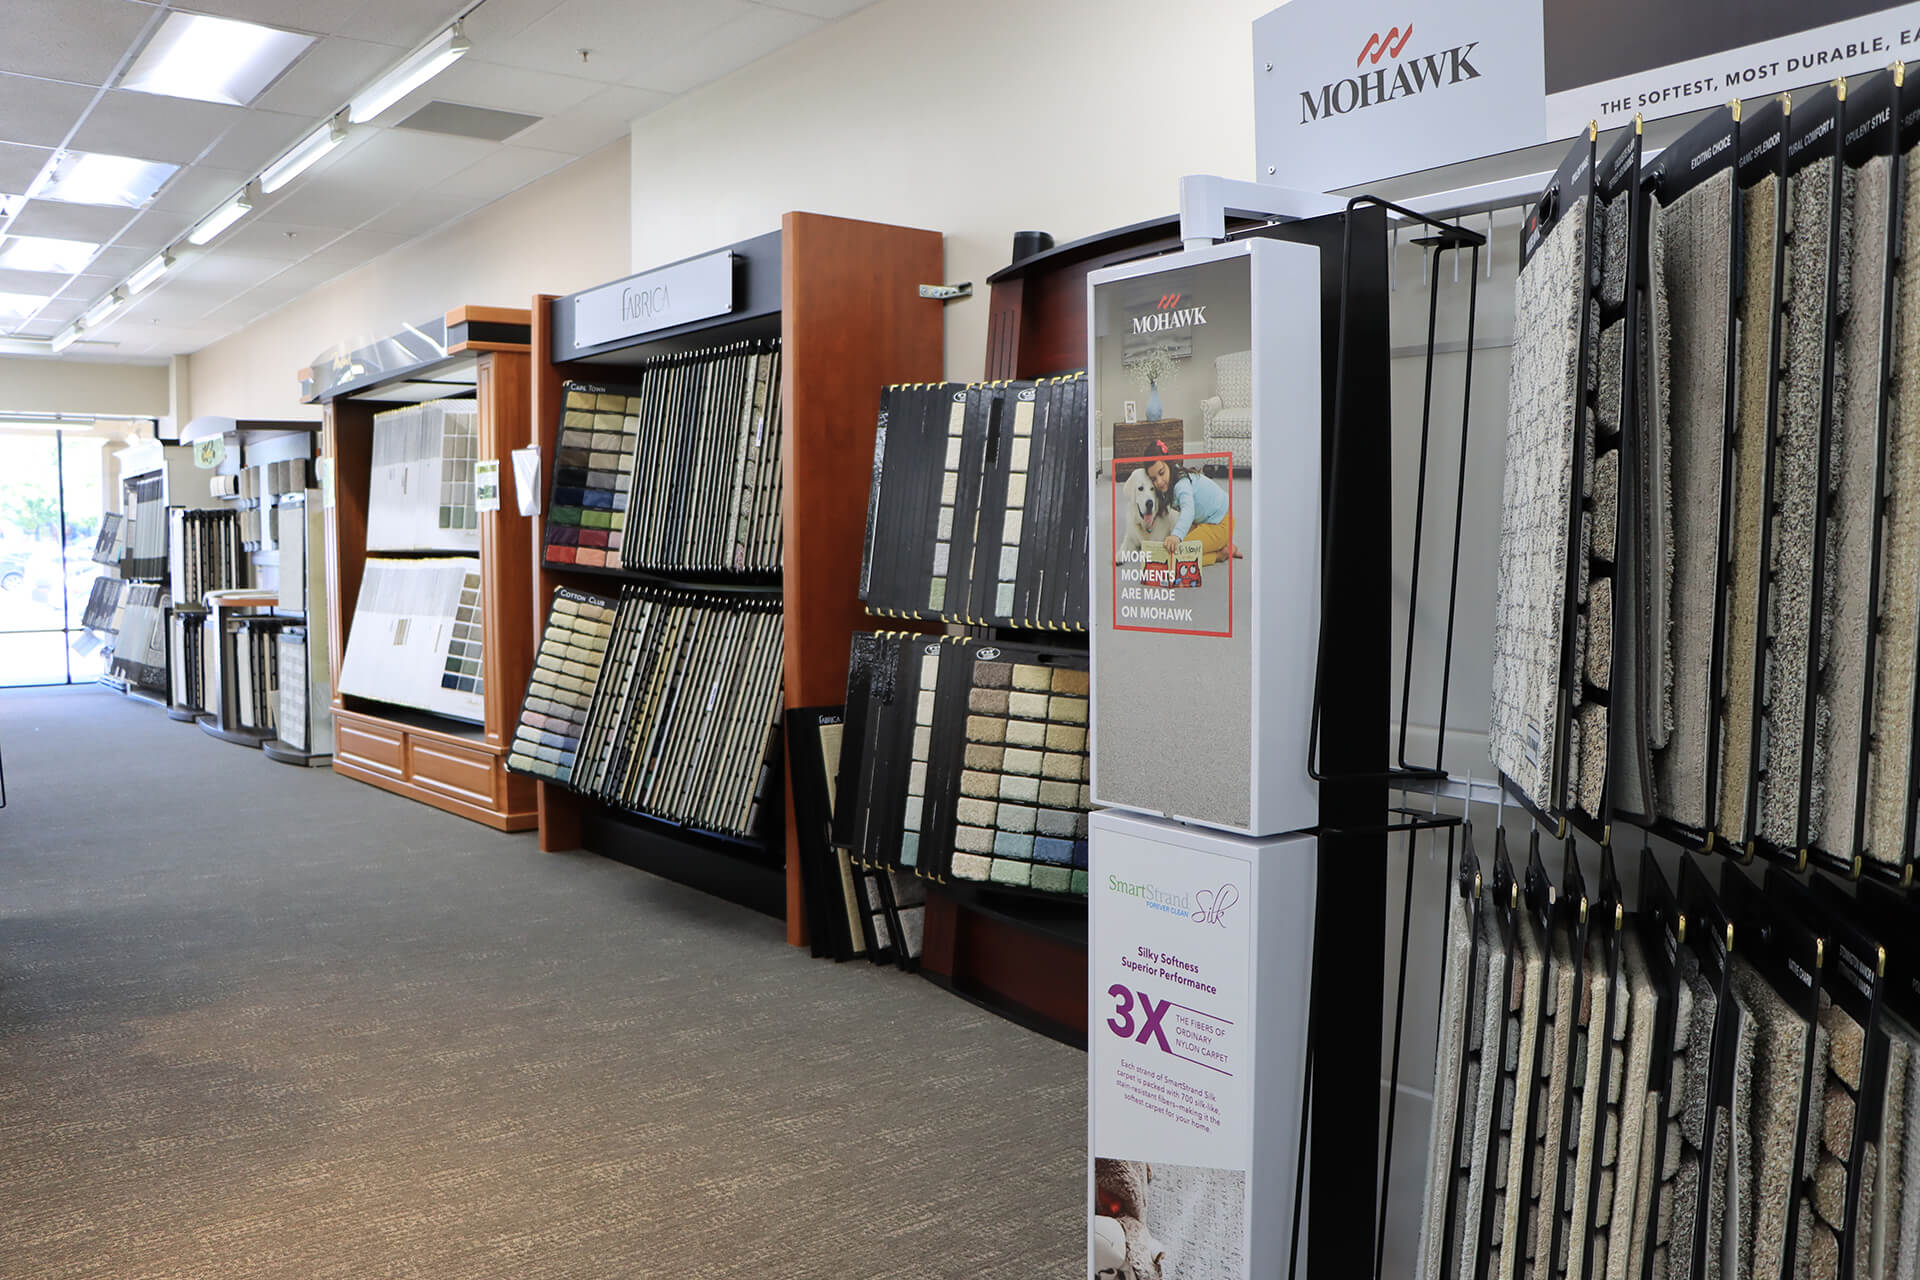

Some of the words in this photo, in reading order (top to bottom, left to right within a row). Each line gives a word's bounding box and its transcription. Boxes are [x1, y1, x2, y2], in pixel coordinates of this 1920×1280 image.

[1299, 41, 1481, 125] MOHAWK
[1601, 97, 1632, 115] THE
[1638, 78, 1719, 107] SOFTEST,
[1725, 62, 1779, 87] MOST
[1786, 37, 1890, 73] DURABLE,
[1870, 106, 1890, 129] STYLE
[1712, 133, 1732, 157] CHOICE
[1754, 131, 1781, 159] SPLENDOR
[622, 283, 671, 322] FABRICA
[1132, 305, 1207, 334] MOHAWK
[1121, 550, 1152, 563] MORE
[1121, 568, 1176, 583] MOMENTS
[1121, 587, 1142, 600] ARE
[1143, 588, 1176, 601] MADE
[1121, 605, 1138, 618] ON
[1140, 606, 1193, 621] MOHAWK
[1108, 874, 1190, 910] SmartStrand
[1190, 883, 1240, 929] Silk
[1146, 900, 1170, 913] FOREVER
[1170, 907, 1189, 918] CLEAN
[1138, 946, 1159, 963] Silky
[1160, 953, 1199, 974] Softness
[1121, 956, 1158, 976] Superior
[1159, 968, 1217, 995] Performance
[1107, 983, 1173, 1054] 3X
[1176, 1014, 1189, 1025] THE
[1190, 1019, 1214, 1034] FIBERS
[1215, 1028, 1226, 1038] OF
[1176, 1026, 1212, 1045] ORDINARY
[1176, 1038, 1200, 1054] NYLON
[1201, 1047, 1229, 1064] CARPET
[1117, 1069, 1136, 1080] carpet
[1143, 1079, 1165, 1093] packed
[1166, 1088, 1180, 1099] with
[1181, 1092, 1194, 1104] 700
[1121, 1059, 1135, 1070] Each
[1136, 1066, 1155, 1079] strand
[1156, 1073, 1163, 1081] of
[1164, 1075, 1203, 1097] SmartStrand
[1165, 1108, 1175, 1118] for
[1175, 1114, 1190, 1124] your
[1209, 1115, 1220, 1126] the
